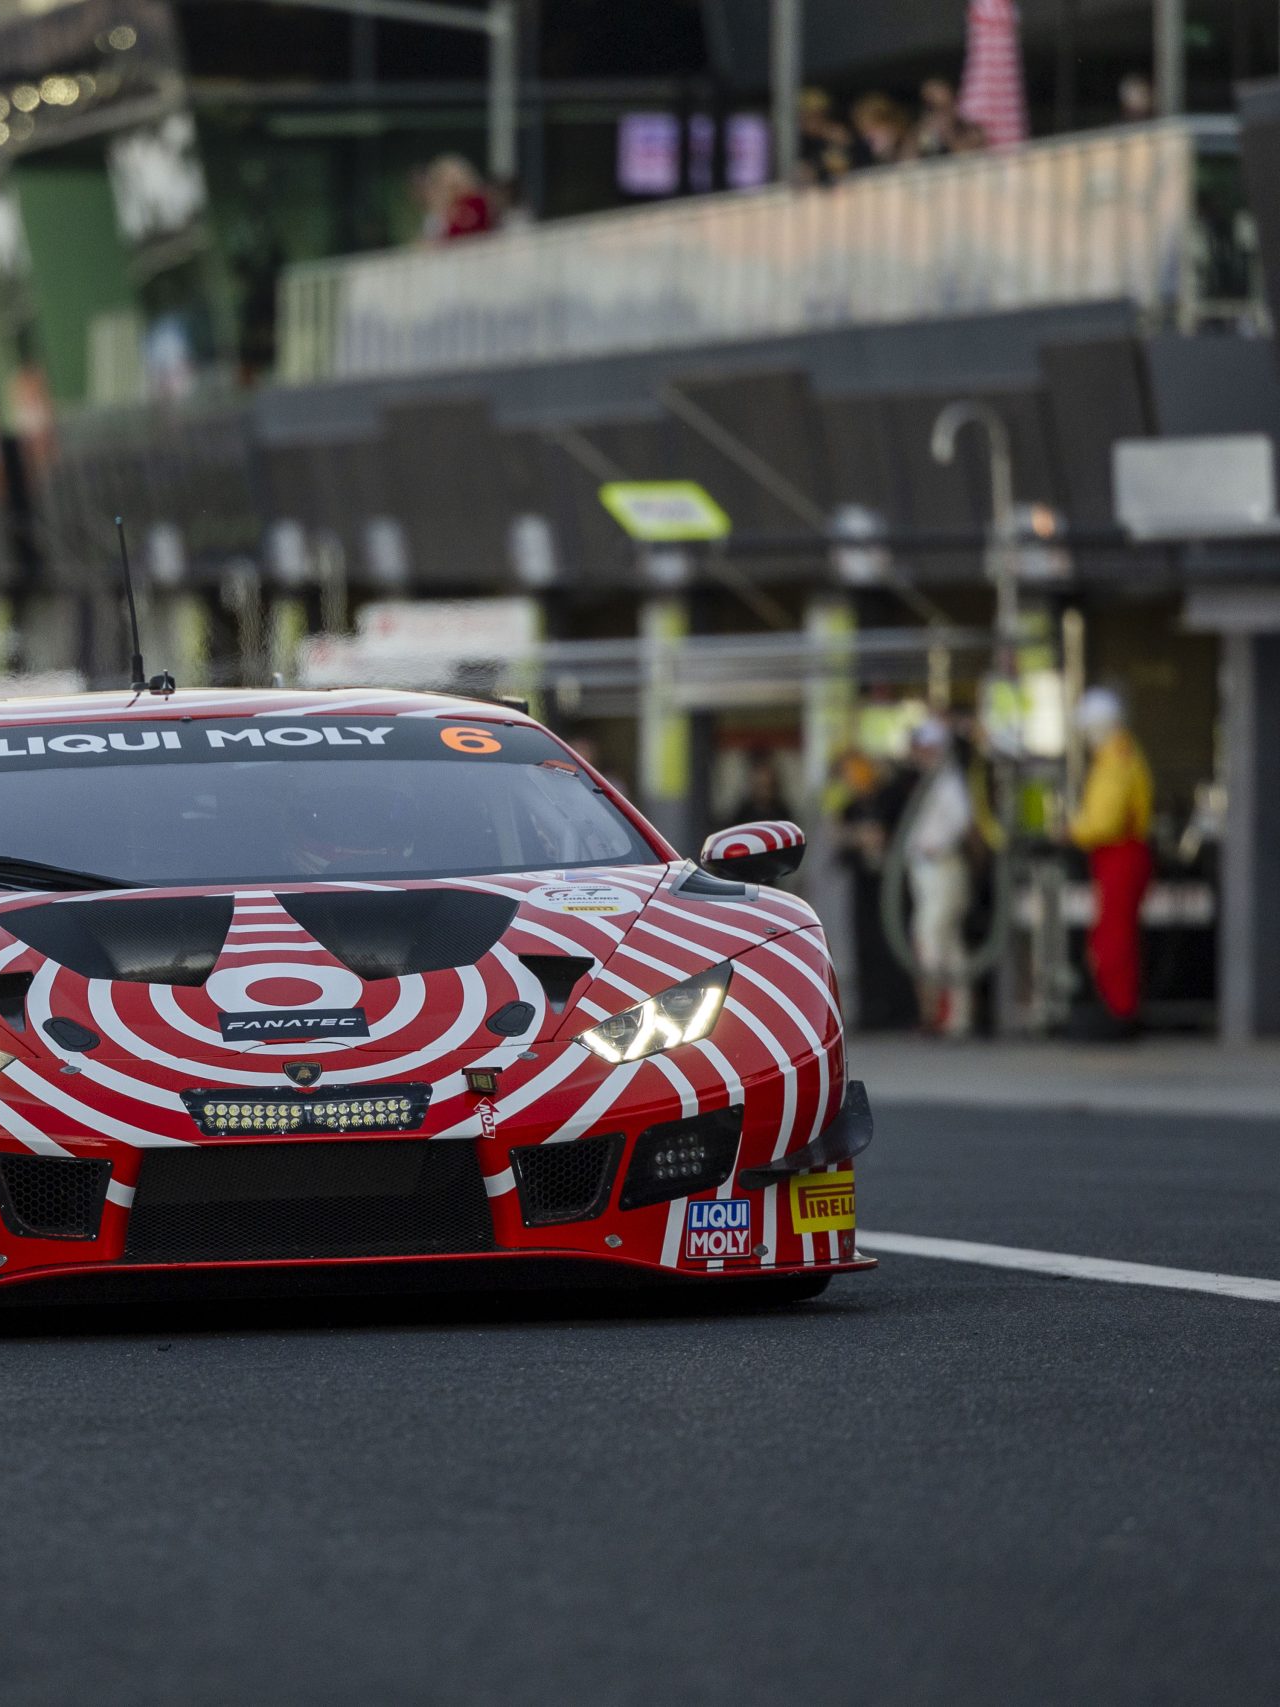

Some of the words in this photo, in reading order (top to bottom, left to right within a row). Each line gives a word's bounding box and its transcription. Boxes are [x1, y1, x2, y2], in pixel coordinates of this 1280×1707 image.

[207, 726, 395, 749] MOLY
[440, 727, 503, 754] 6
[226, 1016, 358, 1031] FANATEC
[479, 1103, 495, 1134] TOW
[798, 1182, 855, 1219] PIRELL
[691, 1203, 748, 1229] LIQUI
[690, 1230, 749, 1255] MOLY
